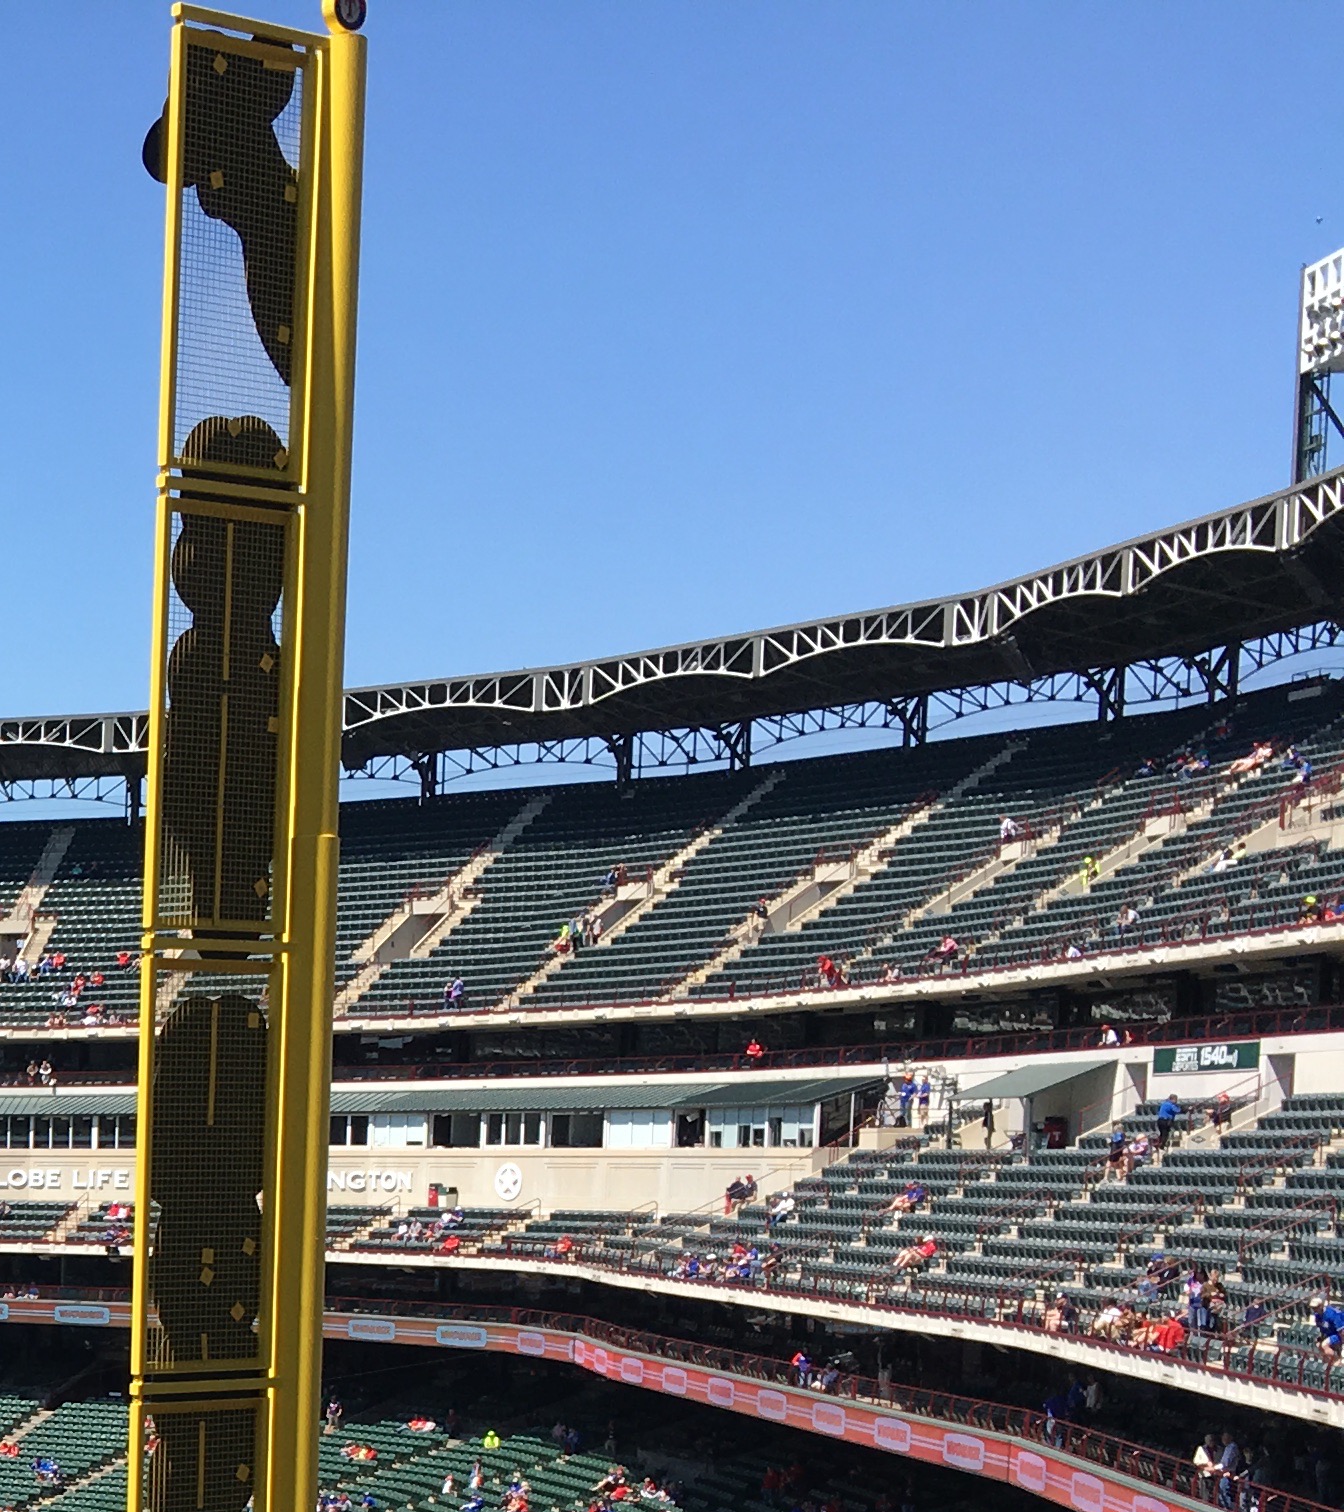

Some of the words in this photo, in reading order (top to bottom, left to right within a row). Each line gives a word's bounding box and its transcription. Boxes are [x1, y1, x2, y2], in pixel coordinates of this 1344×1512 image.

[1200, 1046, 1227, 1066] 1540
[72, 1168, 130, 1190] LIFE
[327, 1168, 412, 1192] NGTON
